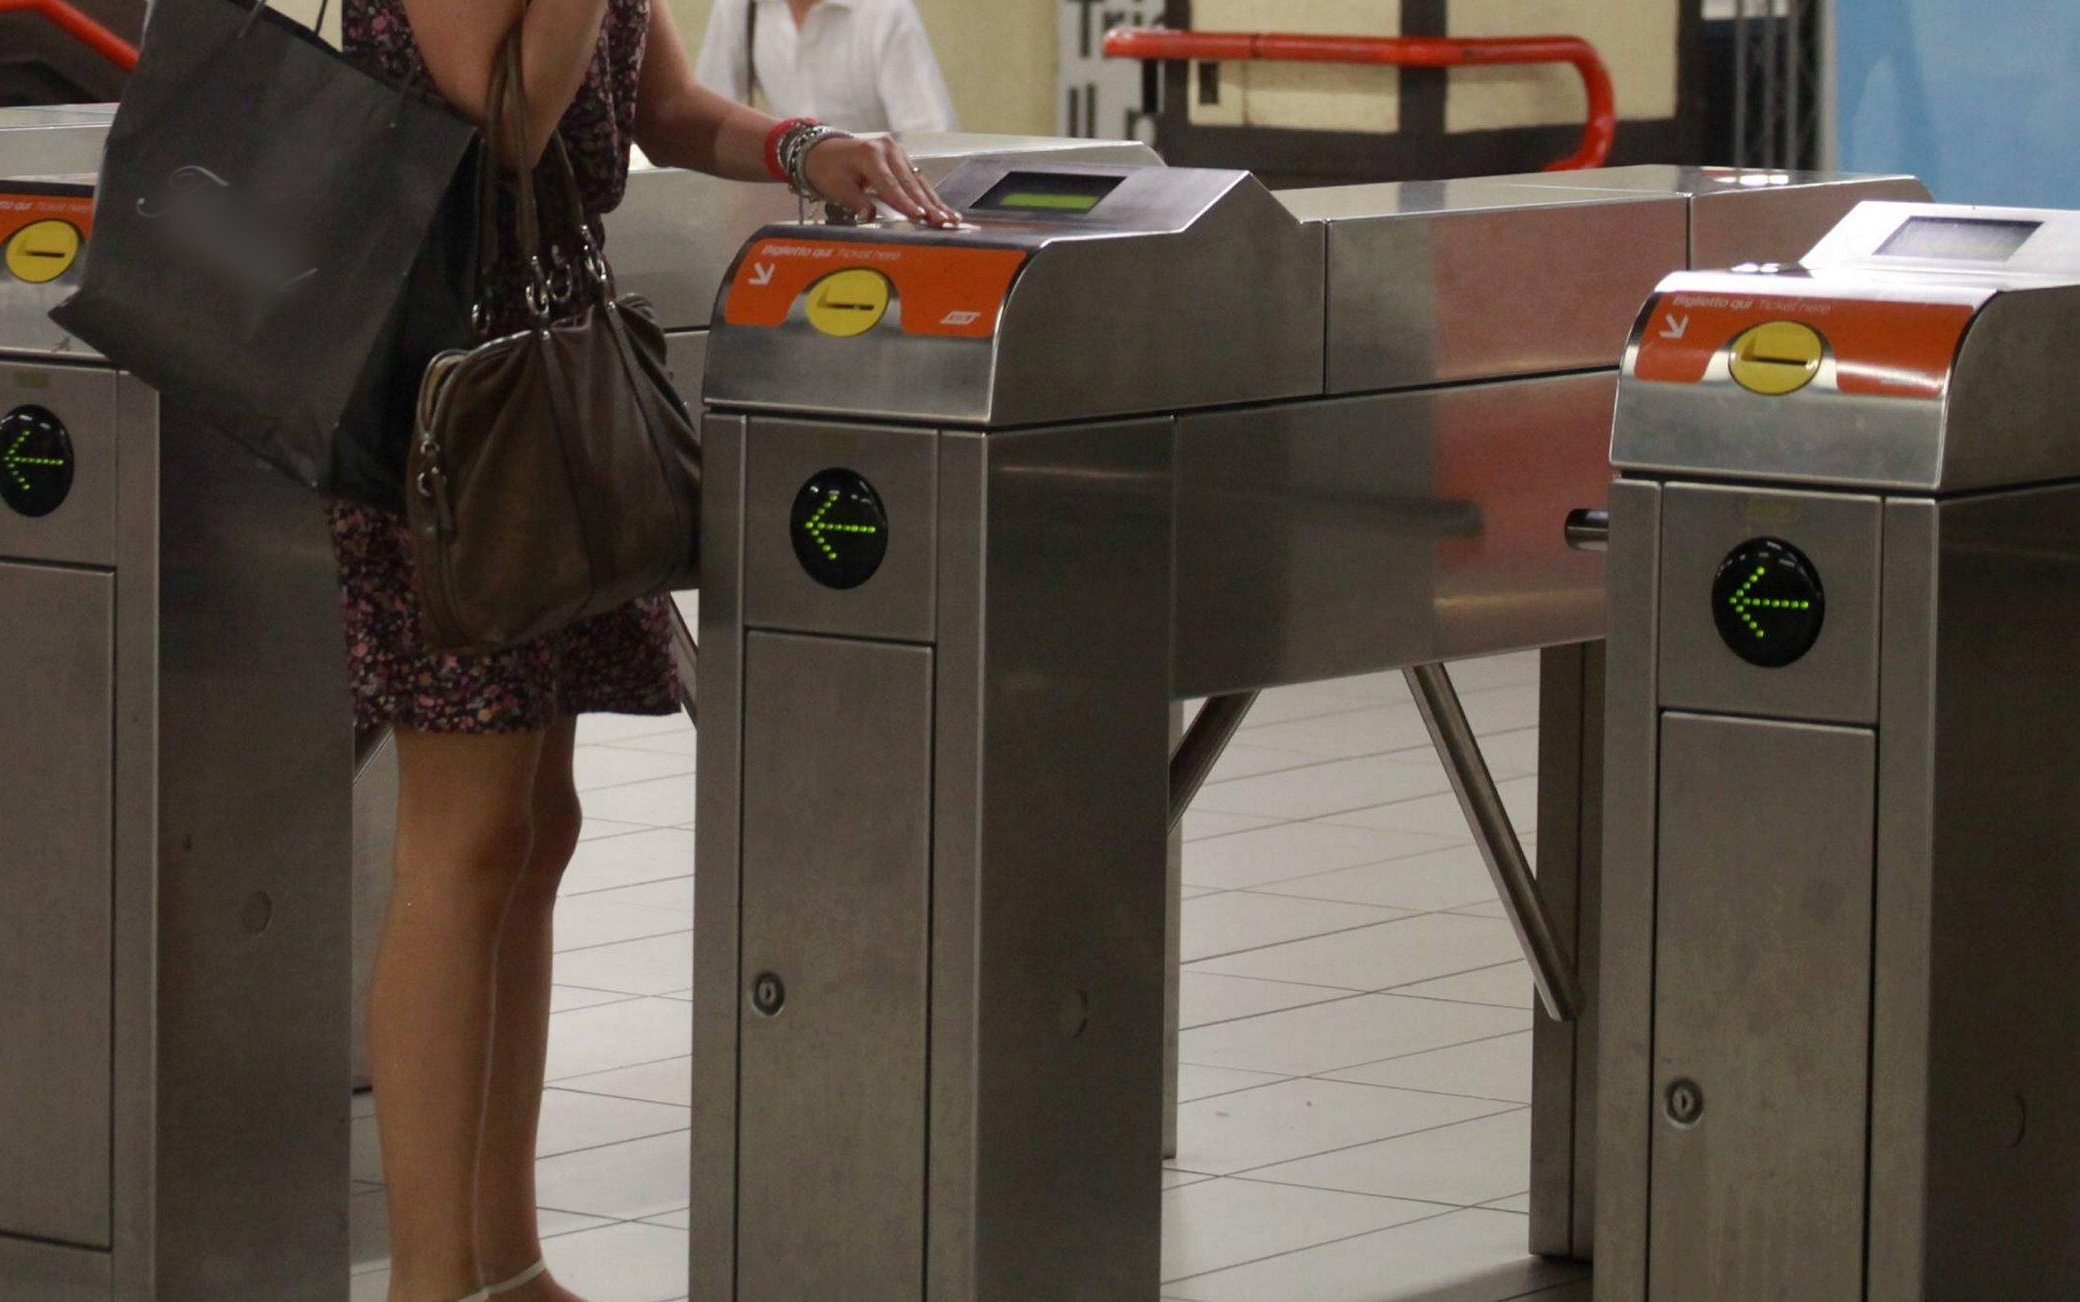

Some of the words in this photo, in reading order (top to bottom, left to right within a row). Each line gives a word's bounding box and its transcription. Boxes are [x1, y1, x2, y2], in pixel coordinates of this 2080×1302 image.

[762, 245, 811, 258] Biglietto
[812, 247, 834, 259] qui
[836, 247, 871, 260] Ticket
[1673, 295, 1728, 308] Biglietto
[1730, 298, 1753, 311] qui
[1759, 298, 1797, 311] Ticket
[1799, 300, 1831, 312] here
